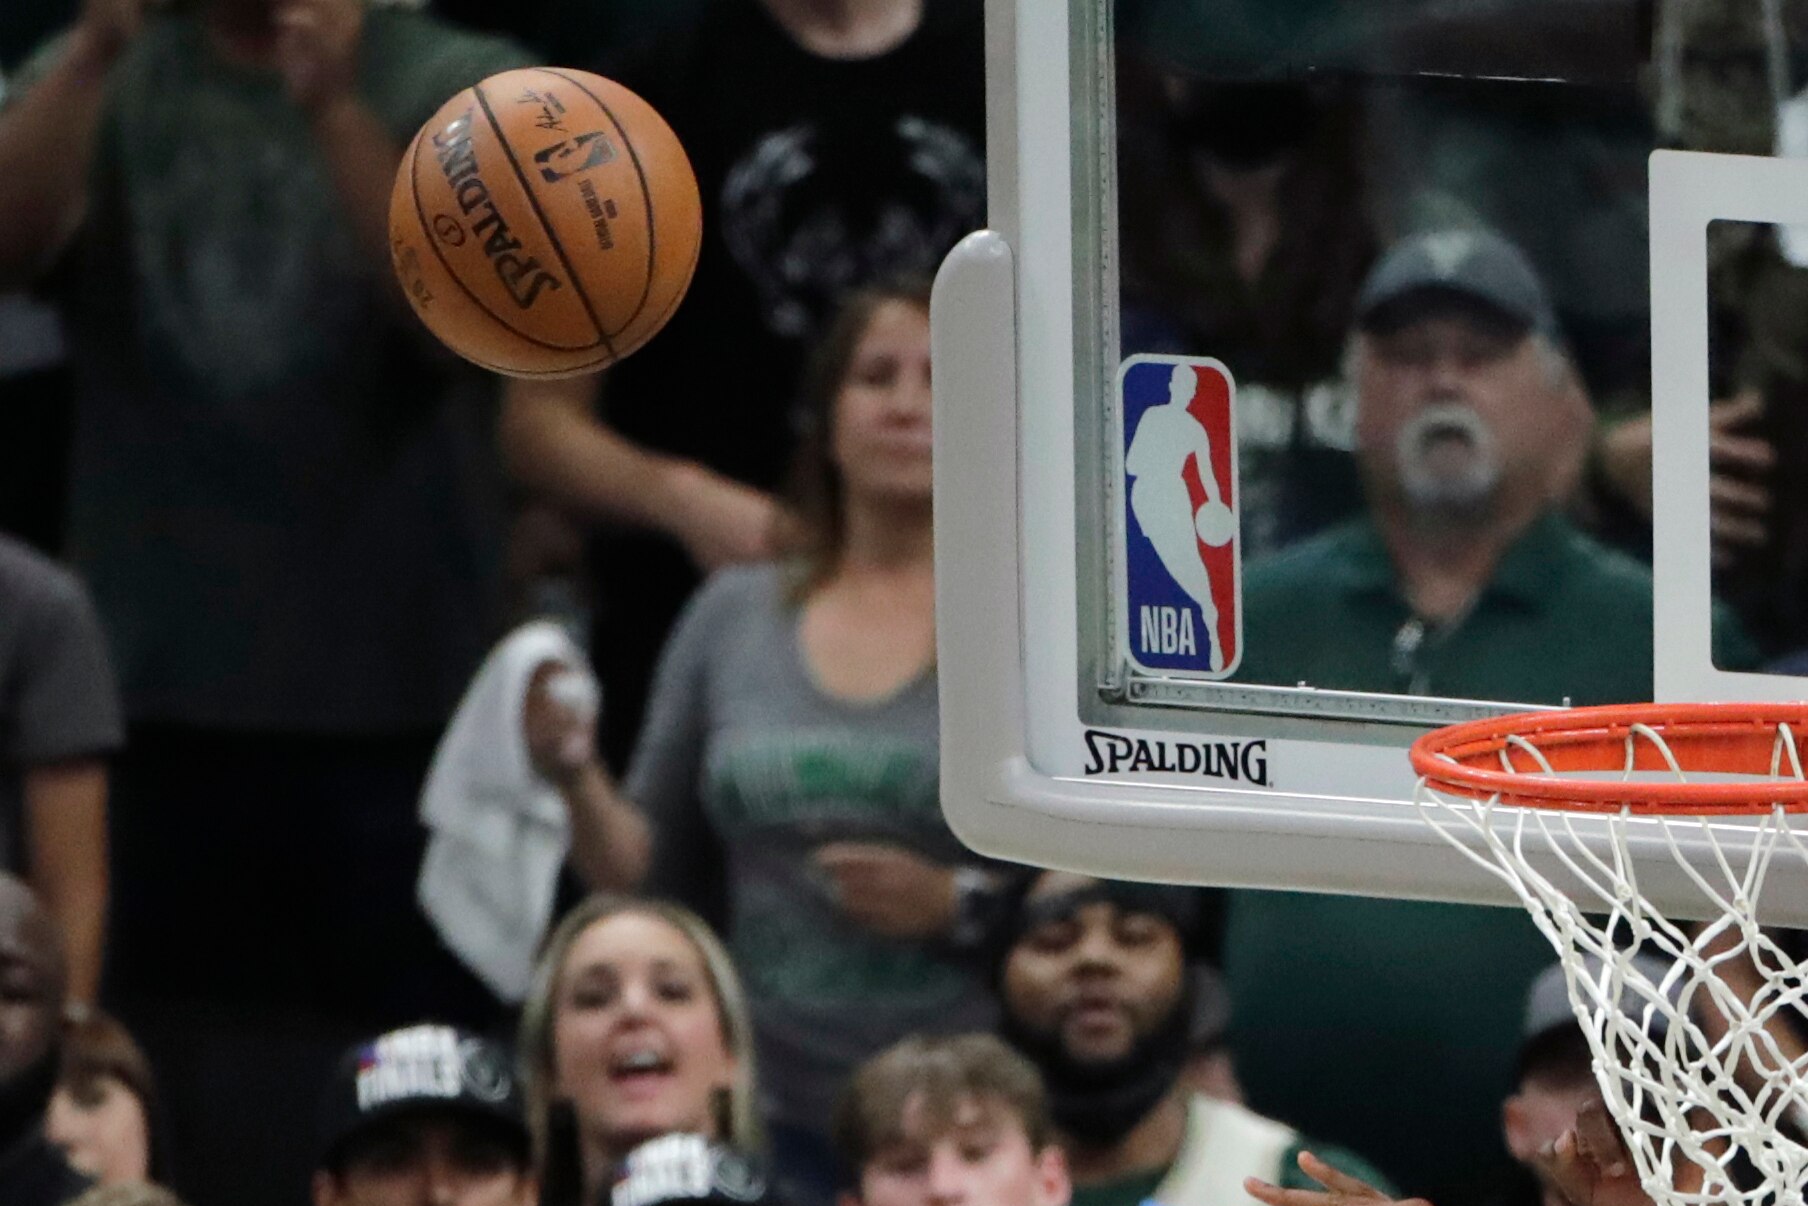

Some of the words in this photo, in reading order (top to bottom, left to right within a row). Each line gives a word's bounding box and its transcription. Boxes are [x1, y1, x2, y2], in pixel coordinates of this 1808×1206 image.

[431, 104, 562, 311] SPALDING
[1140, 605, 1196, 656] NBA
[1083, 729, 1268, 787] SPALDING
